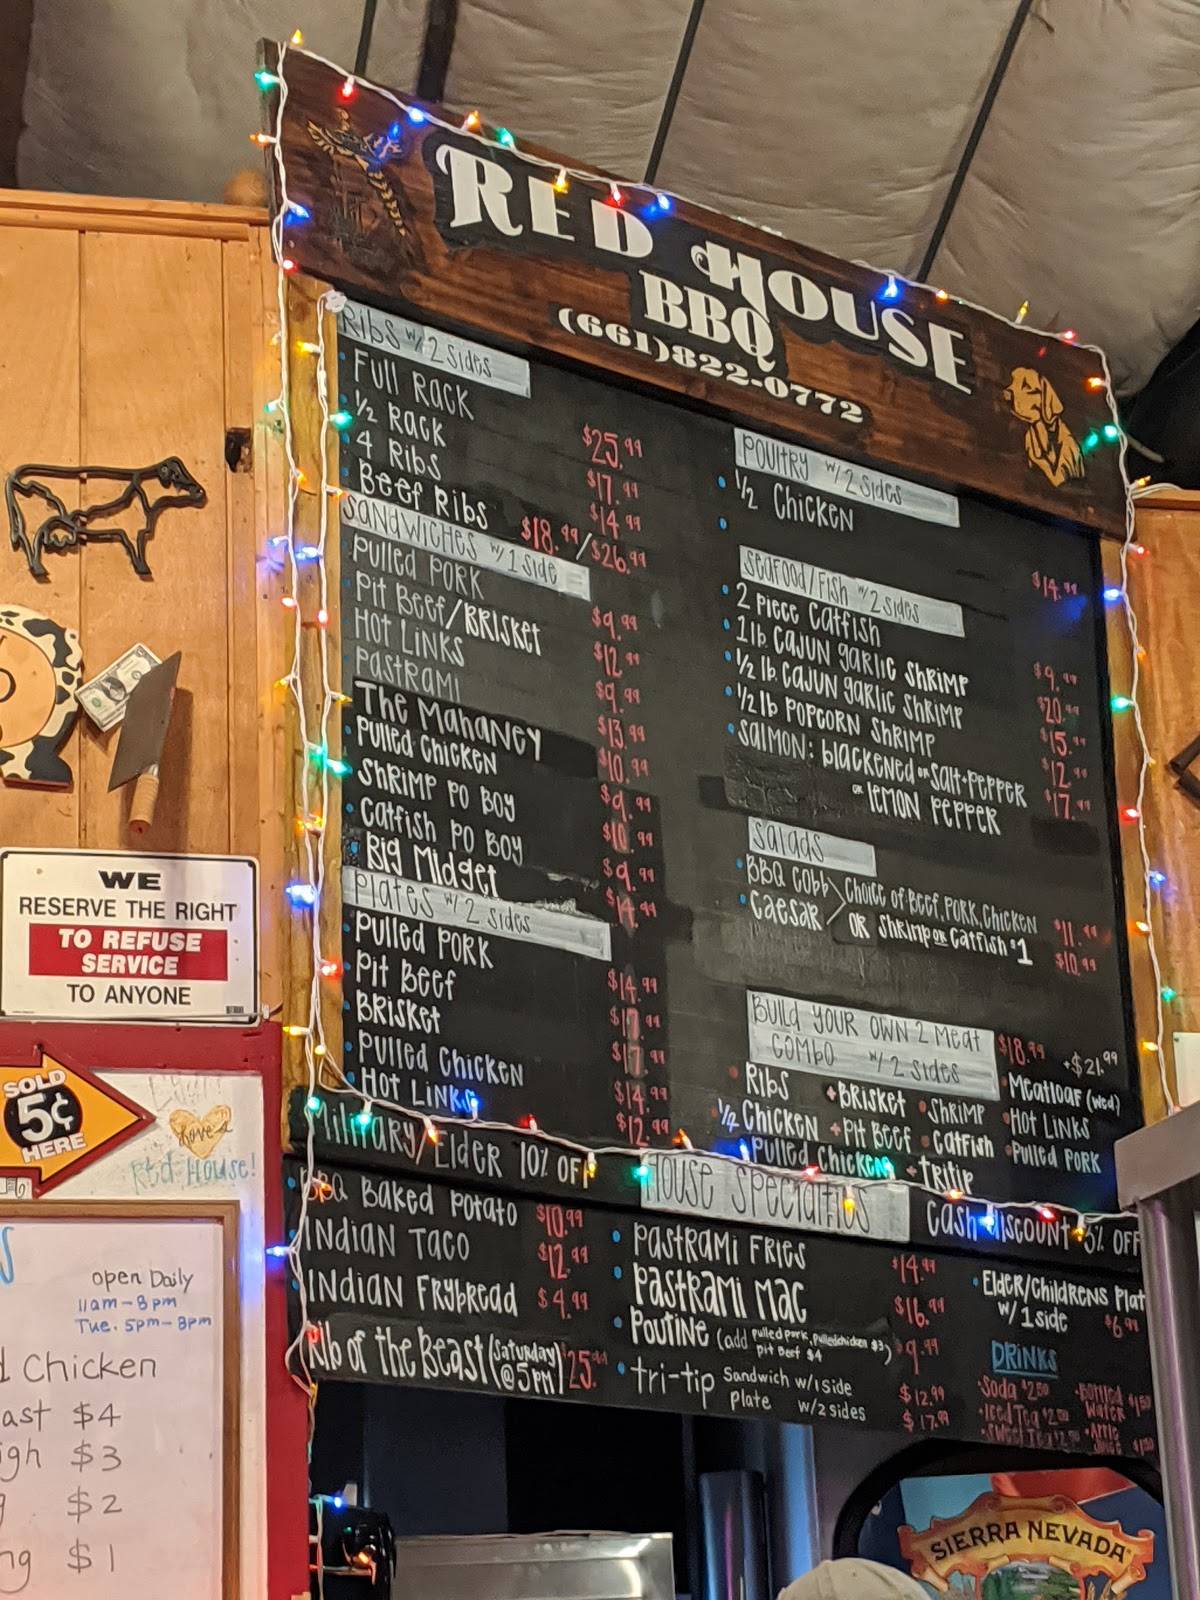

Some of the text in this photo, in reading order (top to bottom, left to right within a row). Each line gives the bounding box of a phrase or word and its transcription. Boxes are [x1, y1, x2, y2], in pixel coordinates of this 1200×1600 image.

[436, 144, 972, 395] RED HOUSE
[341, 304, 400, 351] Ribs
[428, 336, 443, 364] 2
[638, 269, 776, 372] BBQ
[354, 348, 399, 396] Full
[558, 307, 864, 424] (661)822-0772
[356, 430, 442, 481] 4 Ribs
[359, 458, 488, 531] Beef Ribs
[352, 532, 417, 580] Pulled
[355, 570, 387, 610] Pit
[355, 607, 392, 648] Hot
[736, 581, 750, 610] 2
[808, 600, 881, 648] Catfish
[354, 680, 408, 725] The
[356, 715, 415, 759] Pulled
[360, 796, 438, 843] Catfish
[366, 830, 403, 877] Big
[752, 821, 825, 863] Salads
[98, 870, 162, 891] WE
[746, 853, 786, 888] BBQ
[19, 896, 238, 922] RESERVE THE RIGHT
[354, 869, 434, 920] Plates
[465, 898, 480, 925] 2
[58, 928, 203, 953] TO REFUSE
[355, 910, 426, 955] Pulled
[81, 953, 179, 976] SERVICE
[355, 949, 457, 1001] Pit Beef
[66, 983, 192, 1007] TO ANYONE
[358, 1028, 429, 1073] Pulled
[917, 1020, 930, 1045] 2
[935, 1026, 981, 1053] Meat
[2, 1069, 66, 1100] SOLD
[361, 1066, 400, 1101] Hot
[745, 1061, 790, 1101] Ribs
[17, 1092, 75, 1143] 5¢
[843, 1116, 867, 1149] Pit
[872, 1120, 912, 1154] Beef
[1010, 1107, 1038, 1137] Hot
[22, 1132, 88, 1165] HERE
[520, 1141, 549, 1180] 10%
[751, 1135, 809, 1168] Pulled
[361, 1174, 434, 1216] Baked
[450, 1188, 518, 1227] Potato
[926, 1200, 978, 1241] Cash
[408, 1227, 471, 1262] Taco
[150, 1267, 194, 1293] Daily
[23, 1350, 156, 1383] Chicken
[346, 1329, 367, 1375] of
[374, 1326, 416, 1378] the
[417, 1326, 489, 1385] Beast
[630, 1357, 716, 1410] tri-tip
[723, 1366, 790, 1389] Sandwich
[980, 1374, 1018, 1401] Soda
[73, 1401, 121, 1430] $4
[829, 1401, 867, 1422] sides
[71, 1439, 122, 1473] $3
[67, 1486, 123, 1524] $2
[930, 1518, 1127, 1563] SIERRA NEVADA
